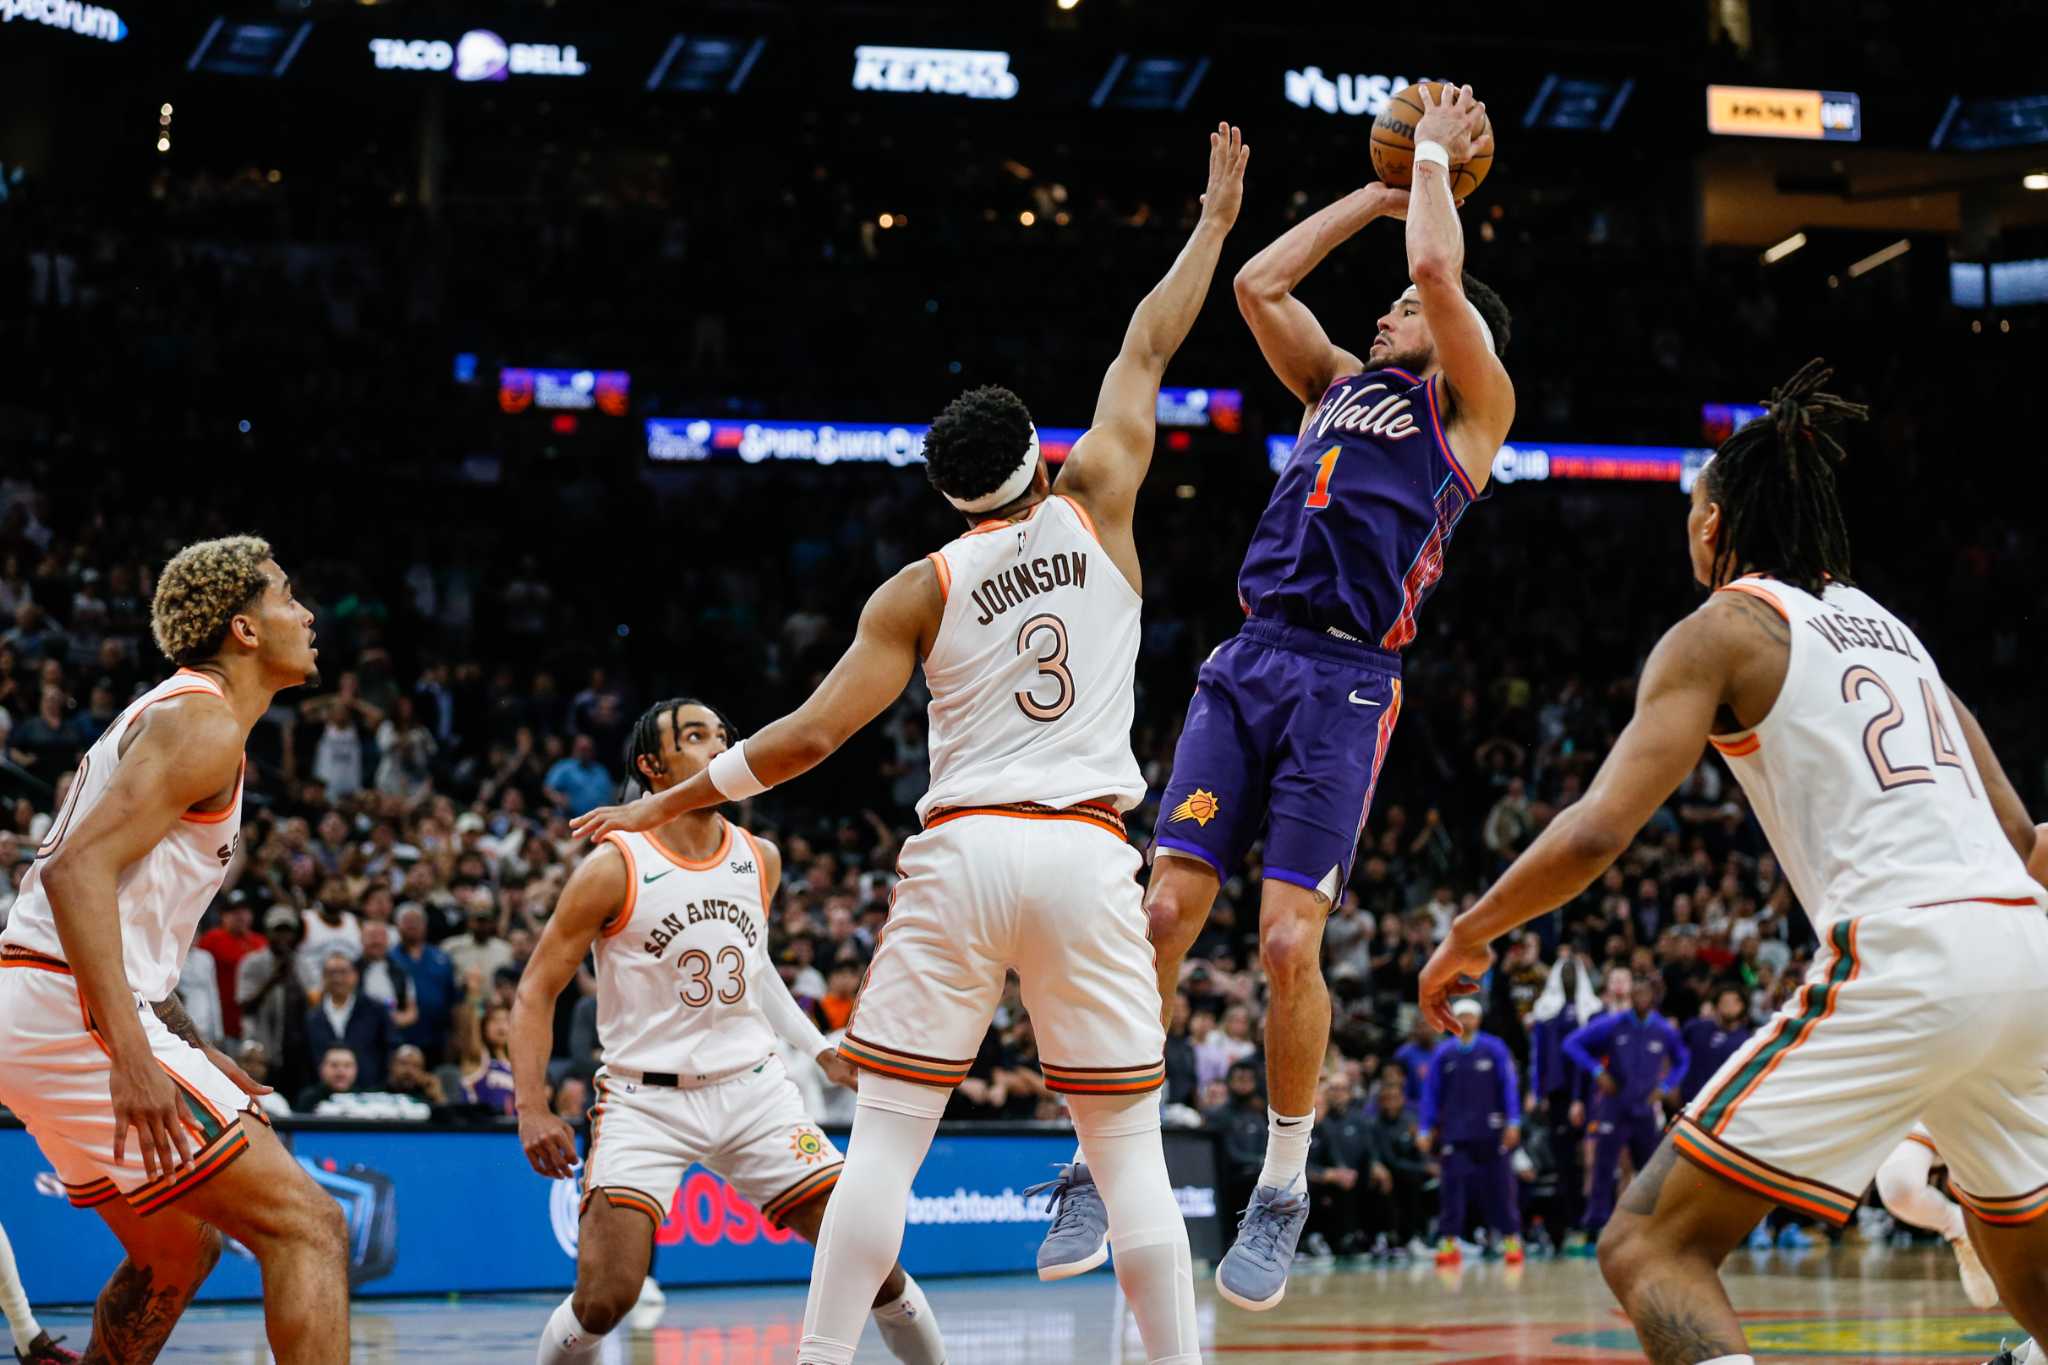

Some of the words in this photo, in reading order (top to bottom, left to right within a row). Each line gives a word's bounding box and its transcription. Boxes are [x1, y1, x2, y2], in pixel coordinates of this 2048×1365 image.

[368, 38, 453, 71] TACO
[508, 43, 587, 75] BELL
[1317, 383, 1422, 440] Valle
[1304, 445, 1342, 509] 1
[971, 551, 1087, 625] JOHNSON
[1015, 613, 1076, 723] 3
[1806, 613, 1921, 664] VASSELL
[1841, 664, 1978, 799] 24
[644, 912, 685, 959] SAN
[686, 899, 757, 948] ANTONIO
[677, 945, 747, 1008] 33
